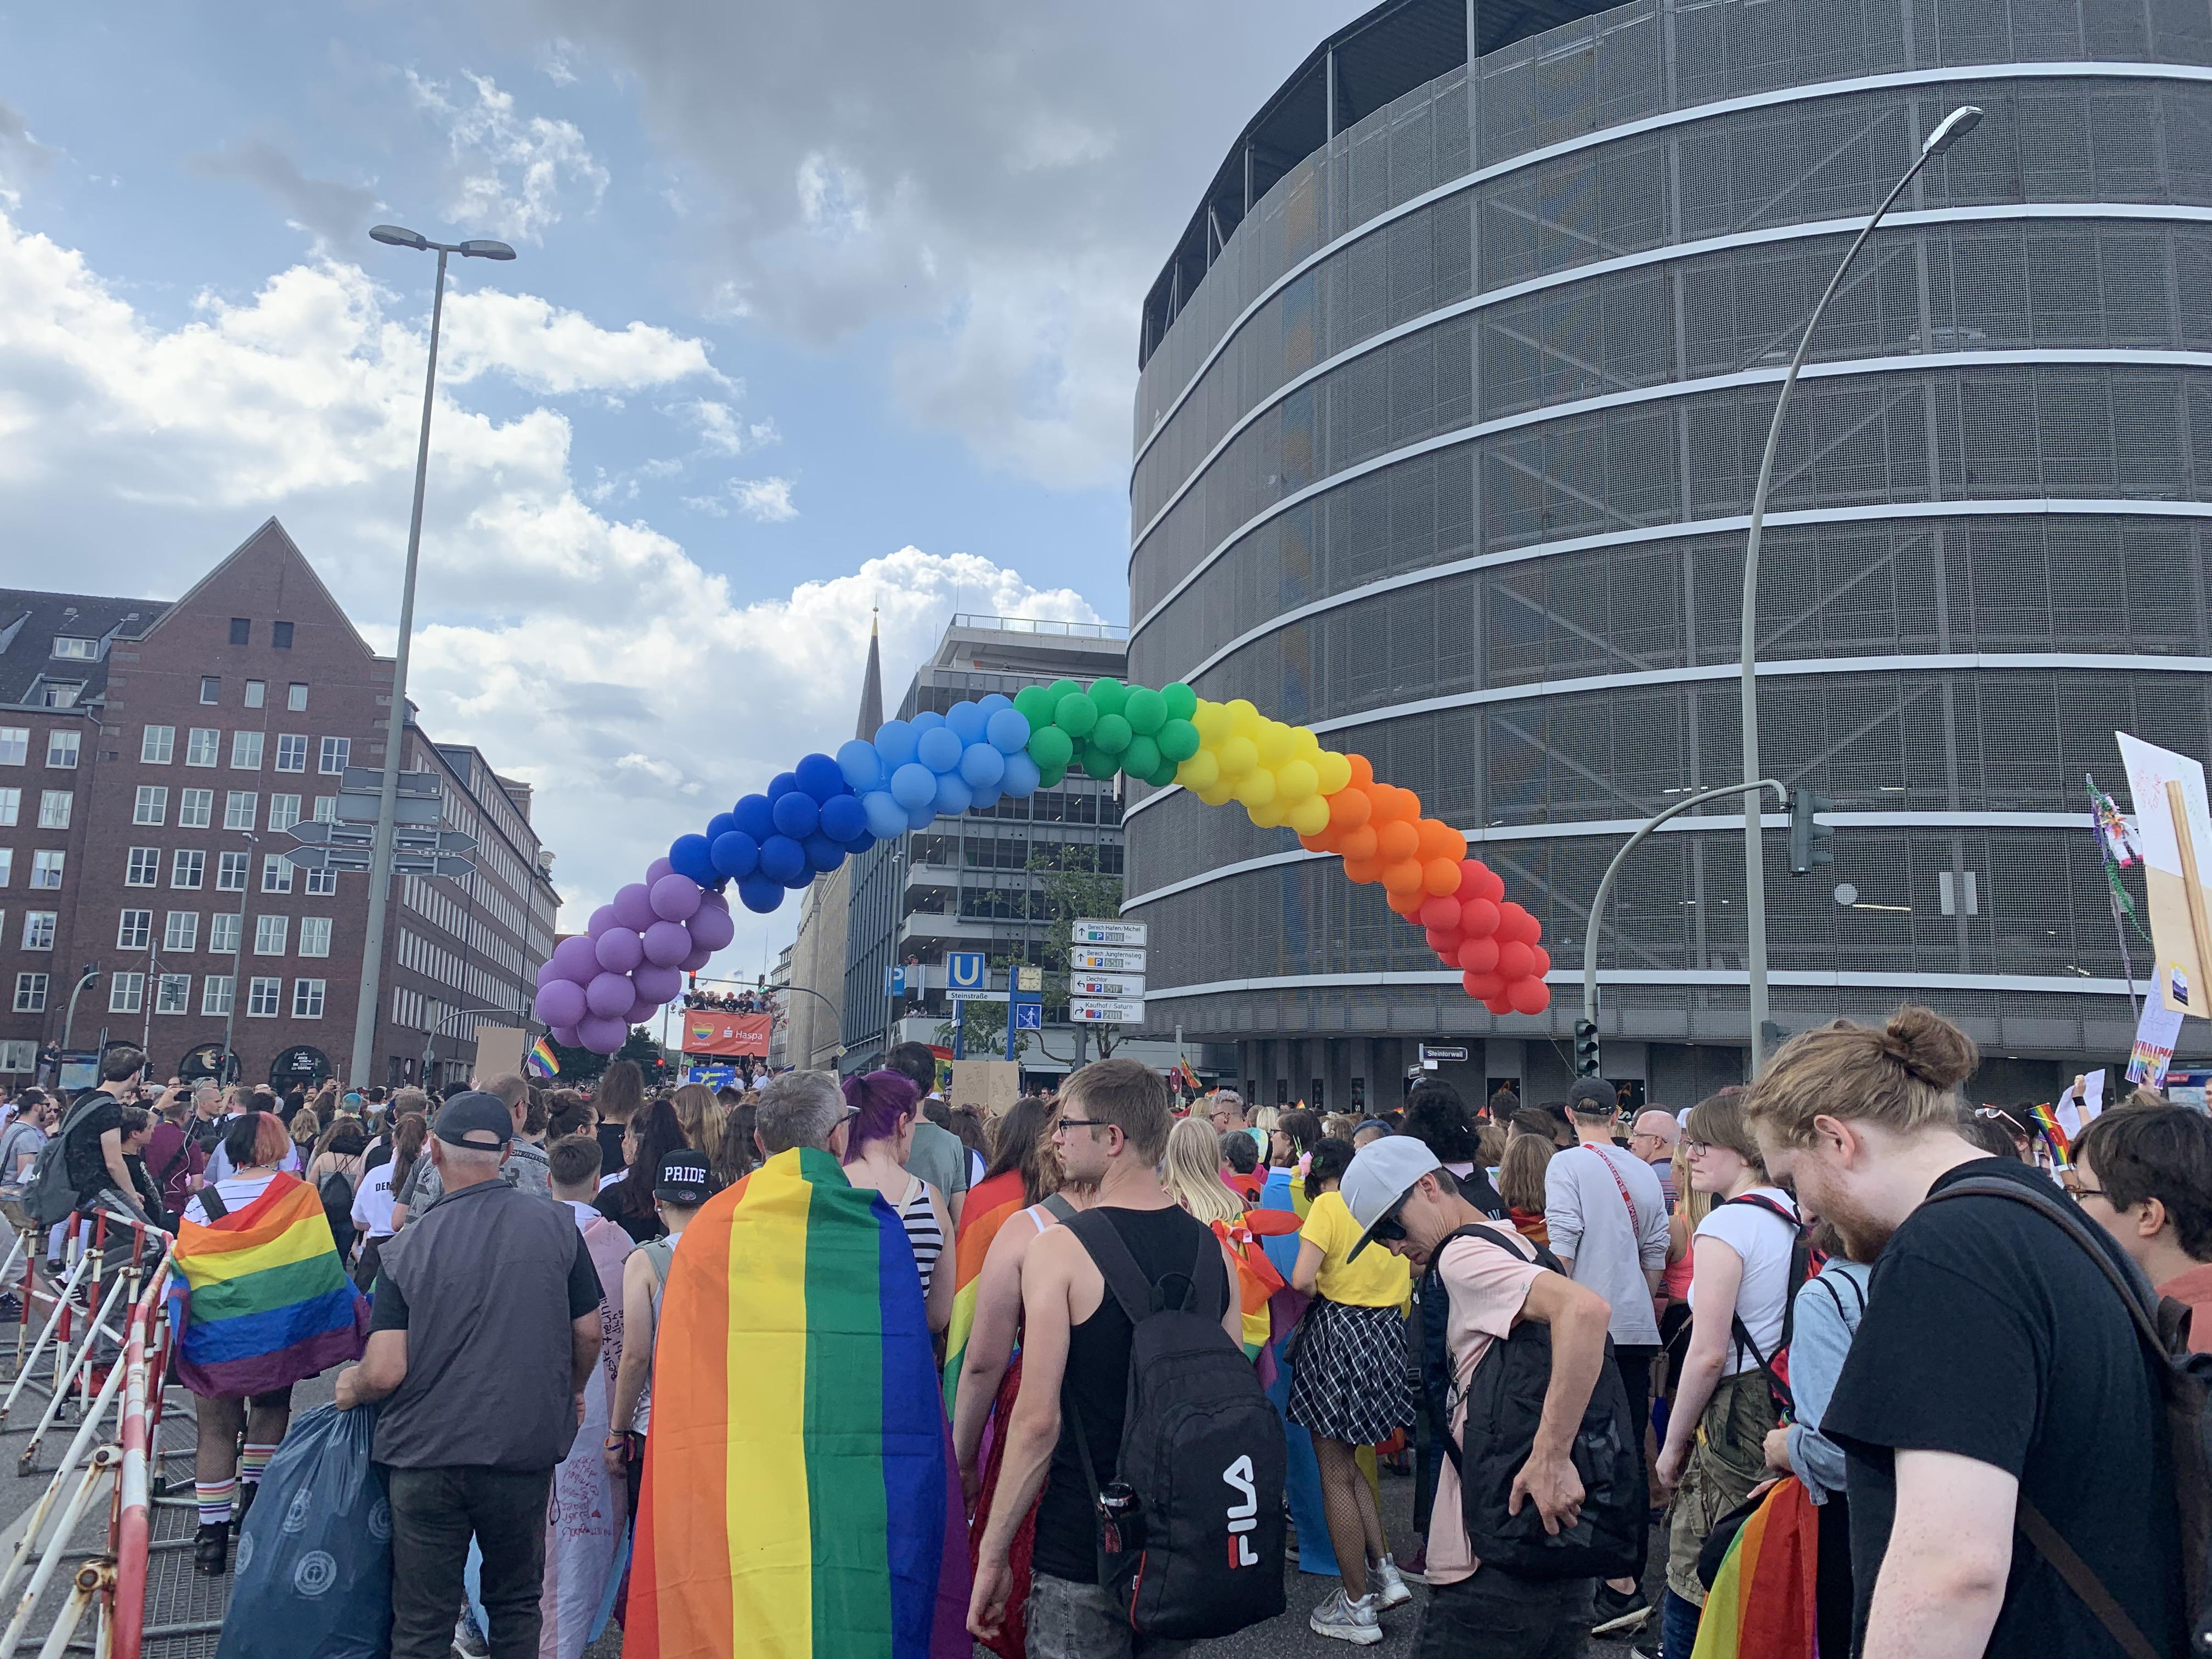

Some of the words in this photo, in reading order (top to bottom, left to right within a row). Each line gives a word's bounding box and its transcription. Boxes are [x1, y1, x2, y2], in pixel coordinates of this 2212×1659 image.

[1105, 951, 1141, 959] Jungfernstieg
[1105, 958, 1122, 967] 650
[889, 967, 904, 987] P
[954, 956, 979, 985] U
[1104, 1011, 1120, 1019] 200
[736, 1030, 763, 1041] Haspa
[664, 1166, 707, 1183] PRIDE
[1223, 1455, 1259, 1569] FILA
